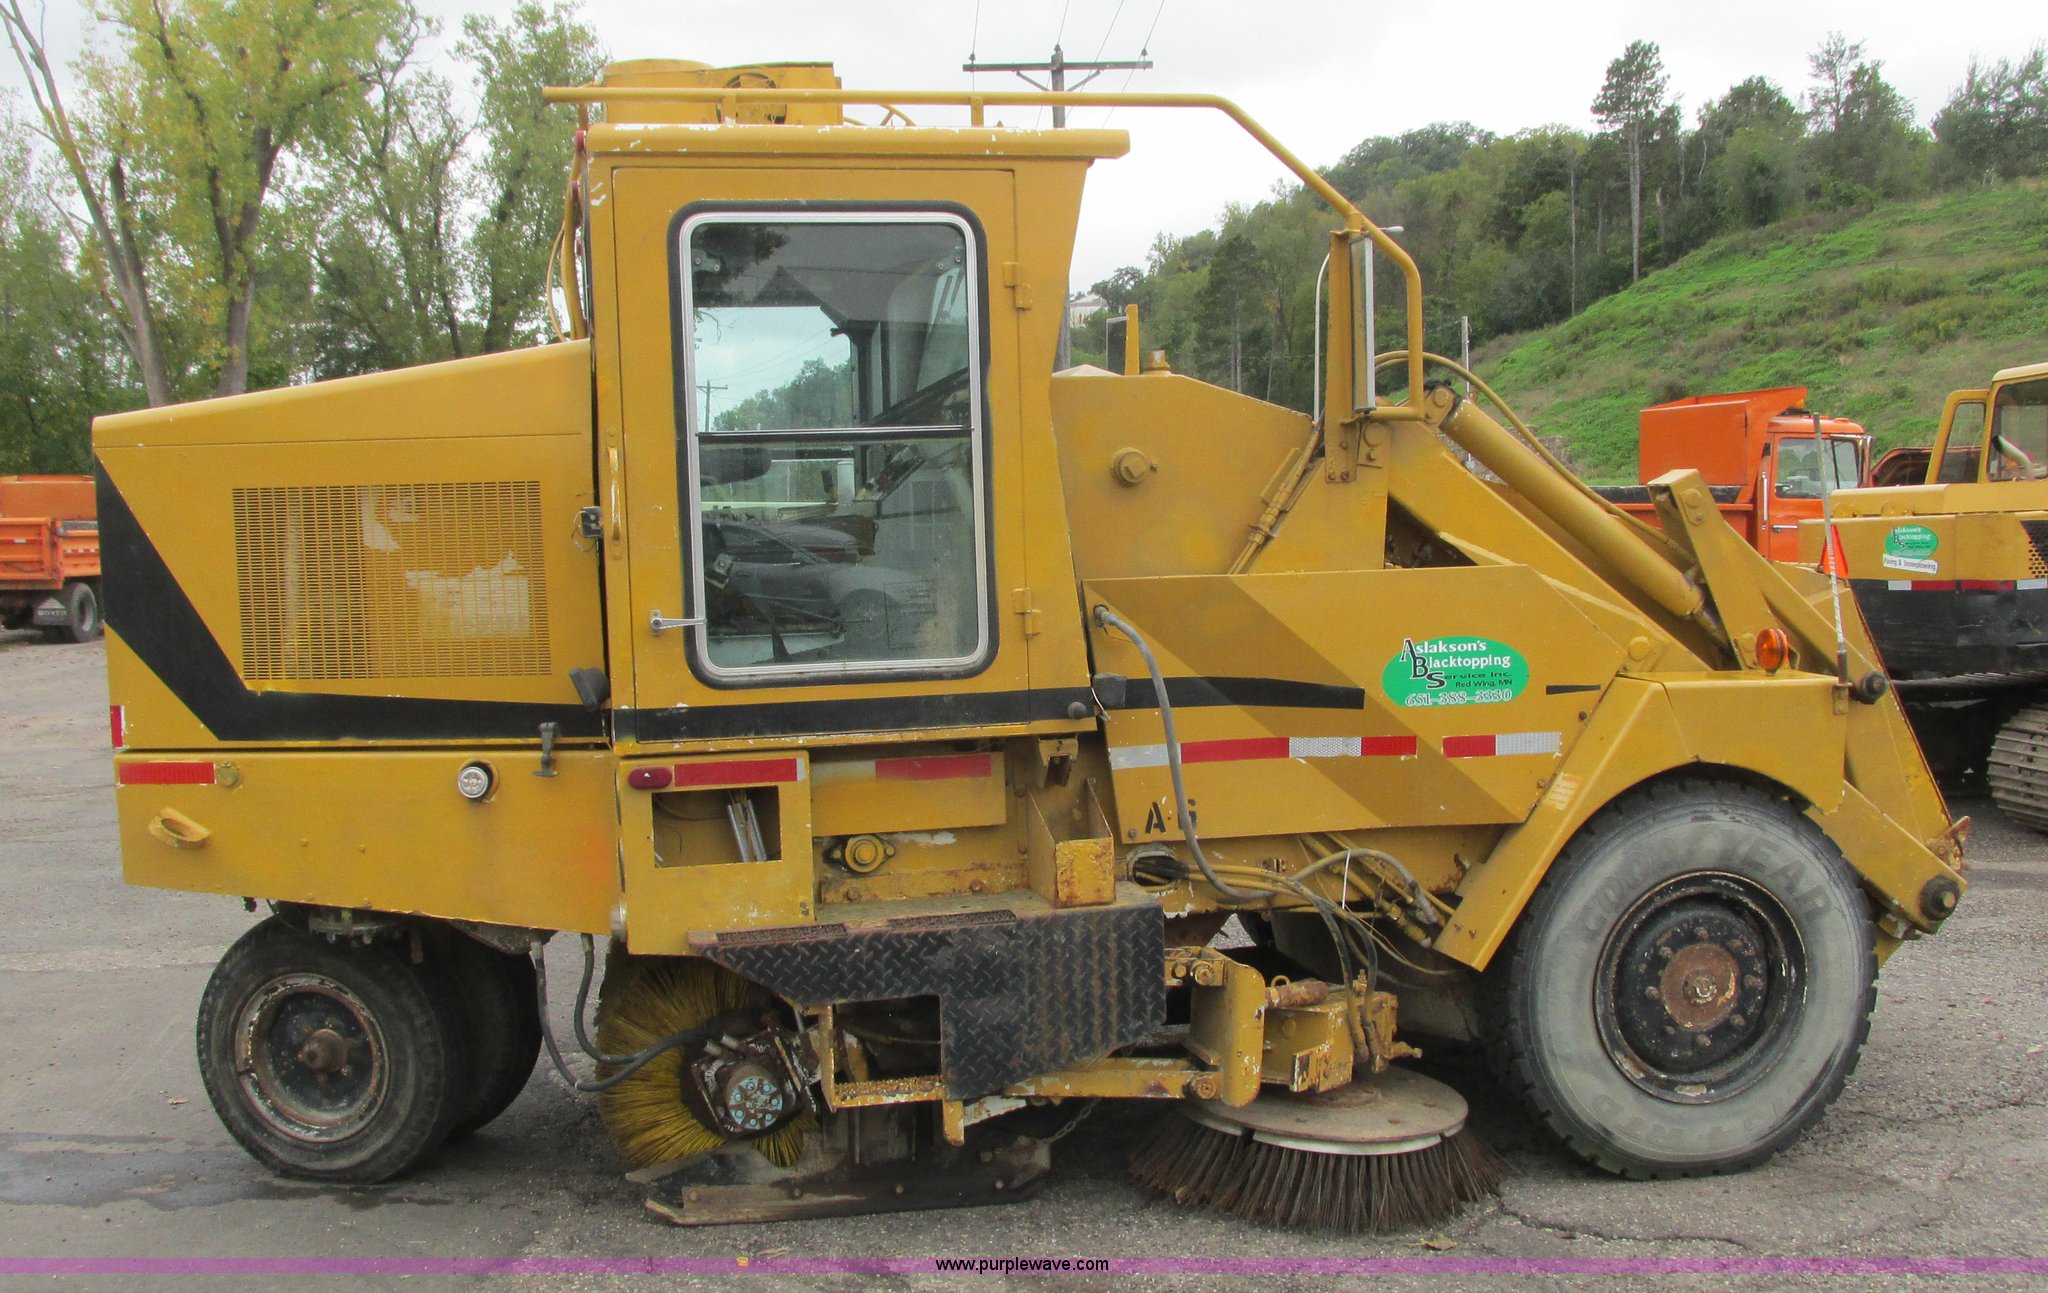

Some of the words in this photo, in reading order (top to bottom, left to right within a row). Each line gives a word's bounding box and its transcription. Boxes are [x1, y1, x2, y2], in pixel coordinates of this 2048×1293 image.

[1400, 638, 1487, 661] Aslakson's
[1410, 654, 1511, 679] Blacktopping
[1426, 671, 1486, 689] Service
[1405, 688, 1513, 706] 651-388-3330
